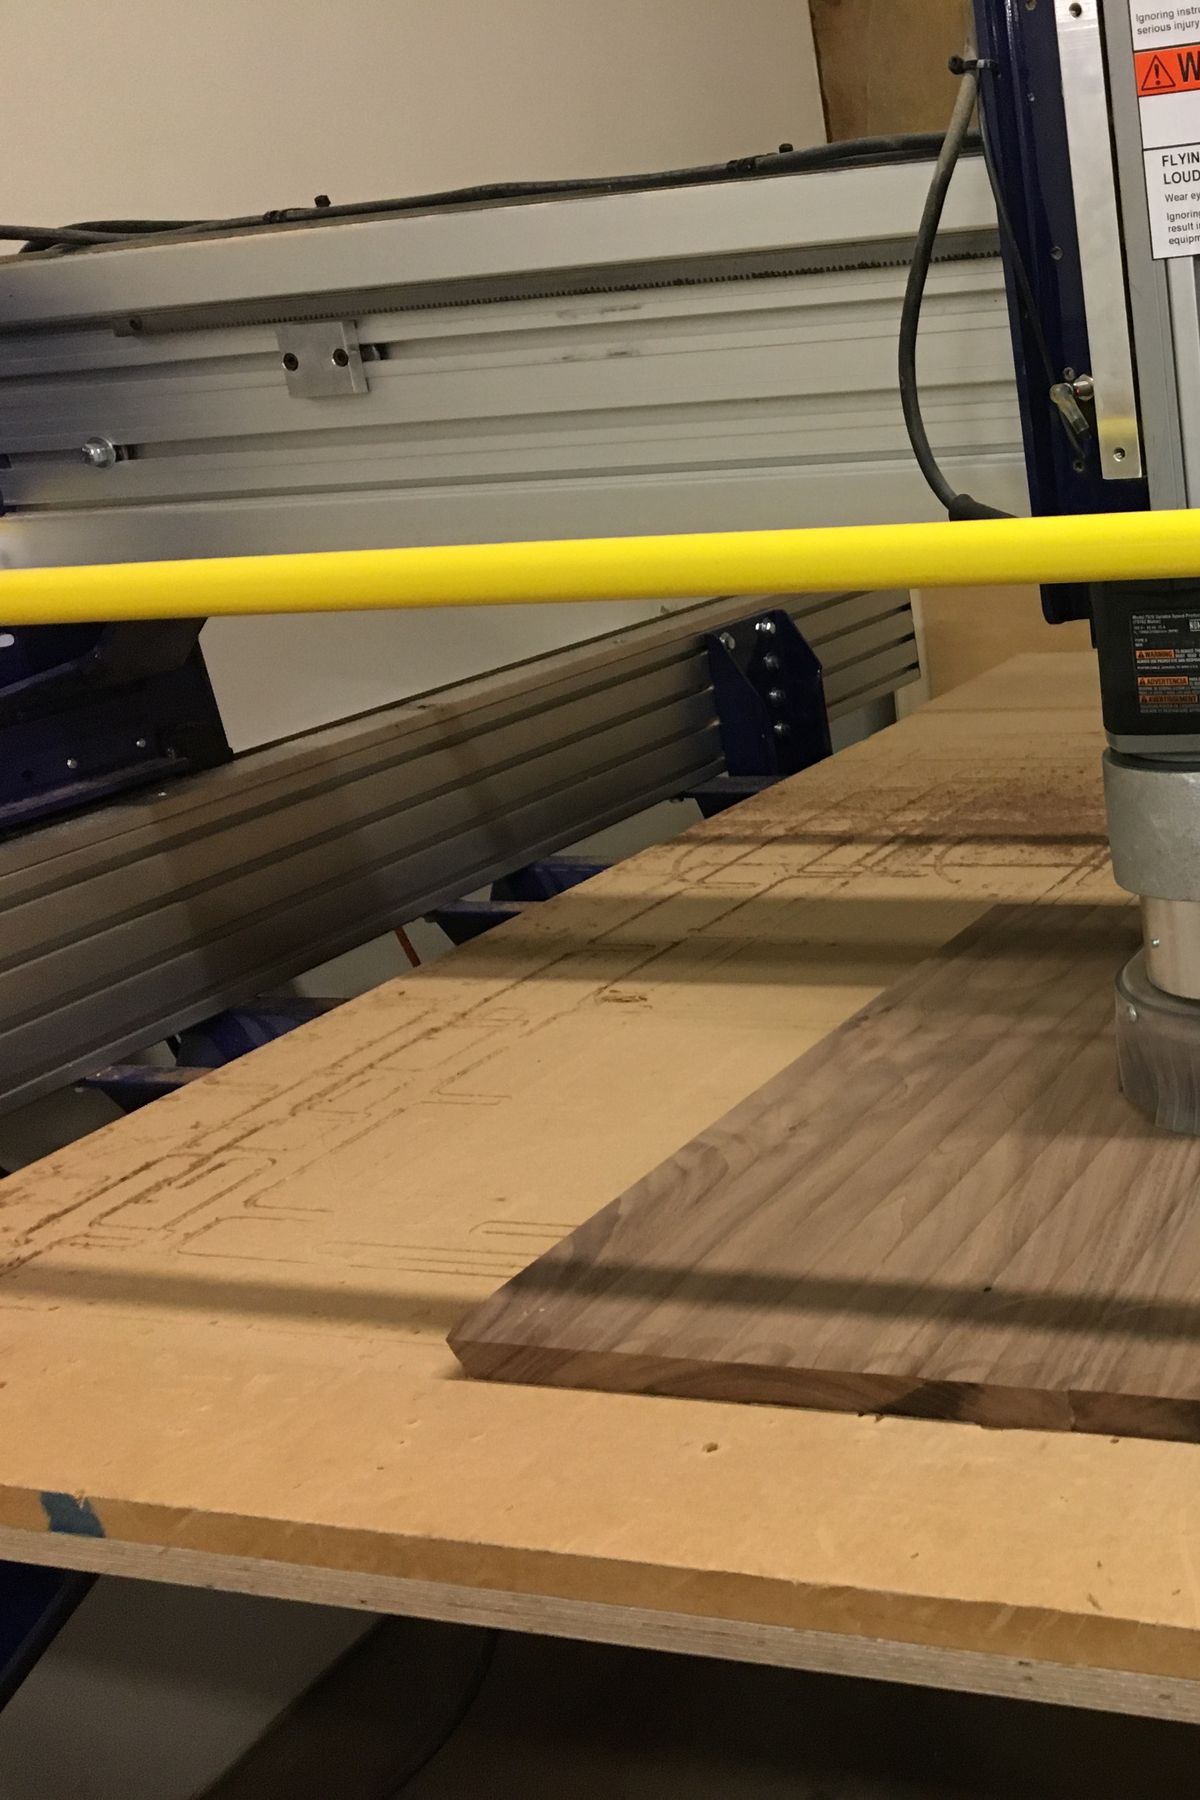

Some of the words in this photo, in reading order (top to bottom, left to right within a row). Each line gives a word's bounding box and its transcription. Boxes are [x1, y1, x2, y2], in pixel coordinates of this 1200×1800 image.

[1136, 10, 1174, 24] Ignoring
[1137, 23, 1172, 35] serious
[1174, 19, 1200, 31] injury
[1163, 169, 1200, 185] LOUD
[1164, 193, 1188, 202] Wear
[1168, 222, 1194, 232] result
